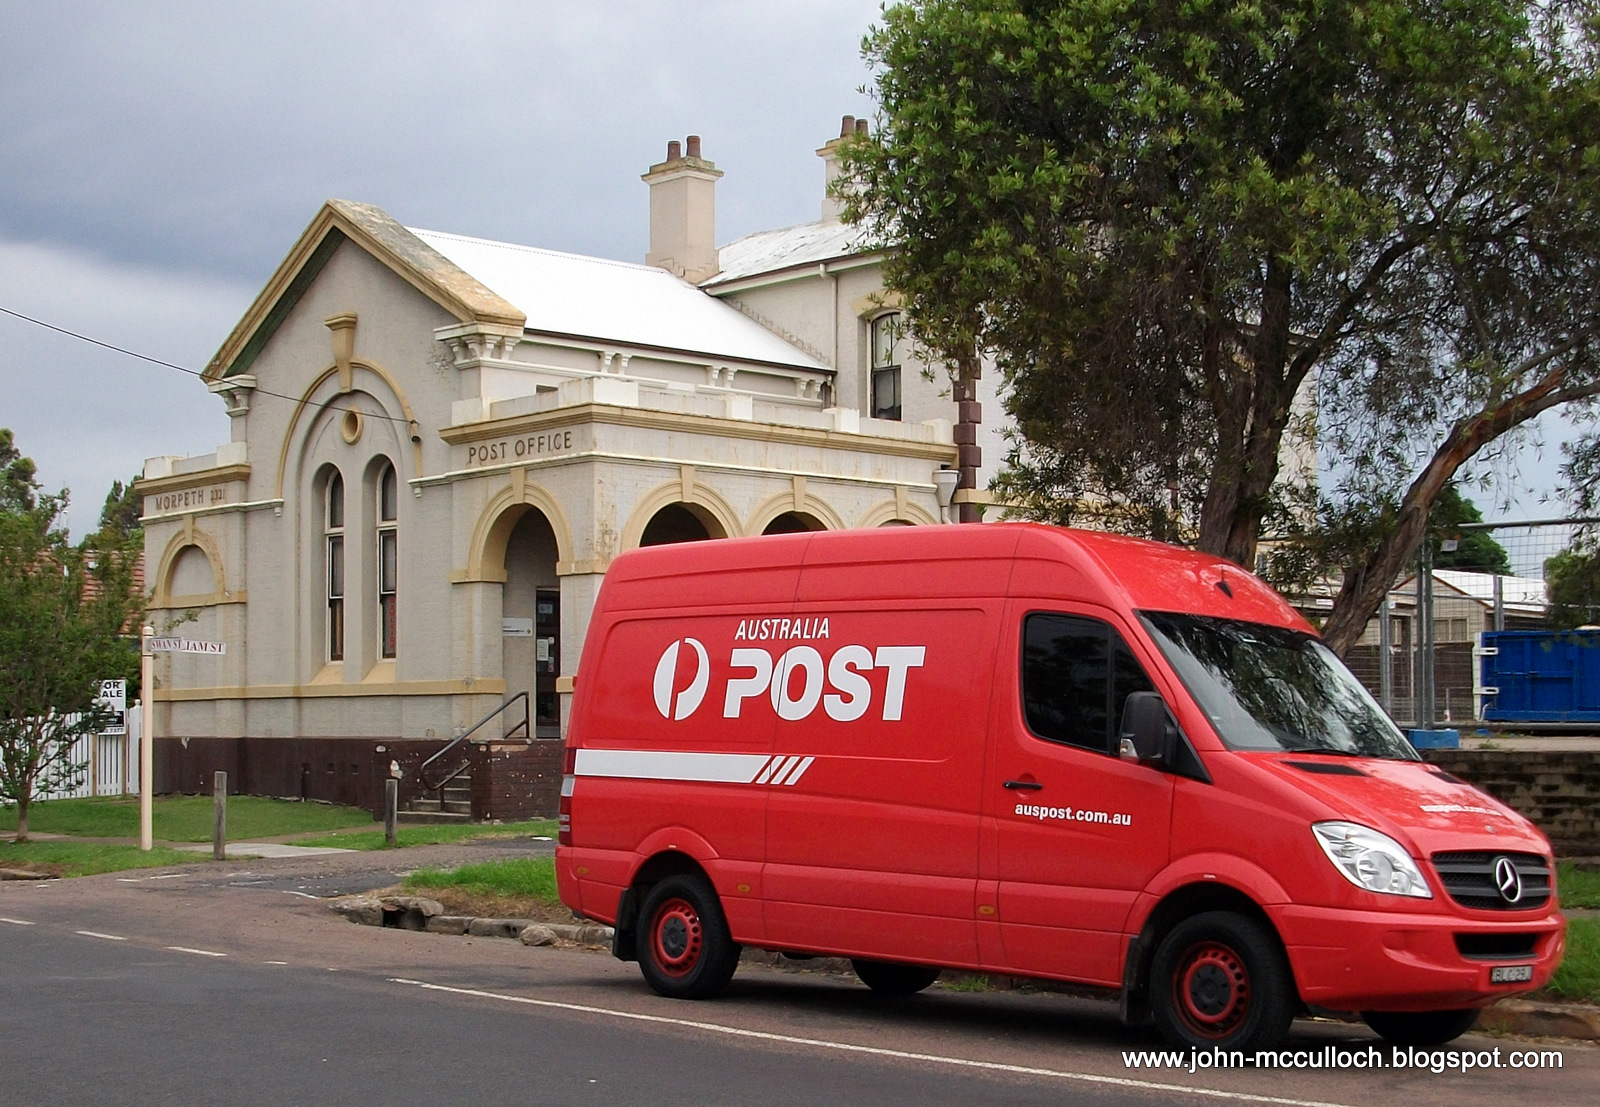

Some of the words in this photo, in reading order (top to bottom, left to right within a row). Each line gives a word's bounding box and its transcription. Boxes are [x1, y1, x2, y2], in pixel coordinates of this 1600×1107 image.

[468, 442, 507, 463] POST
[515, 431, 572, 456] OFFICE
[156, 489, 204, 511] MORPETH
[734, 617, 830, 640] AUSTRALIA
[151, 640, 171, 650] SWAN
[173, 640, 181, 650] ST
[210, 643, 224, 653] ST
[102, 690, 123, 698] ALE
[104, 681, 120, 689] OR
[723, 645, 926, 722] POST
[1015, 804, 1131, 826] auspost.com.au
